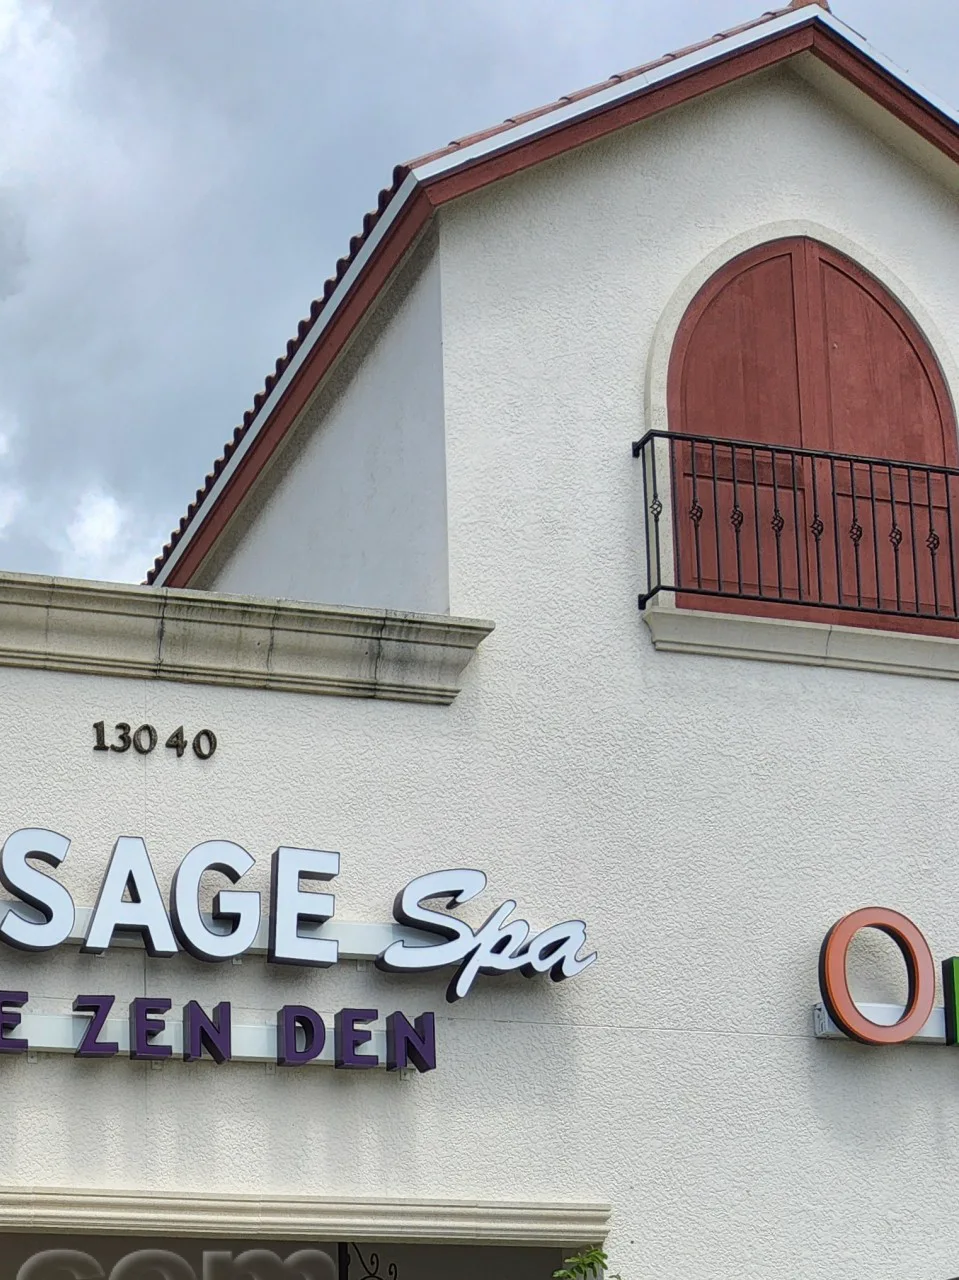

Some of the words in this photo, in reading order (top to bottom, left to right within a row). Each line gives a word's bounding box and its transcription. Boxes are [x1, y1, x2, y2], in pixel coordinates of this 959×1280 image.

[93, 720, 218, 760] 13040
[375, 867, 598, 1002] Spa
[818, 906, 959, 1046] O
[72, 994, 232, 1064] ZEN
[276, 1005, 437, 1073] DEN
